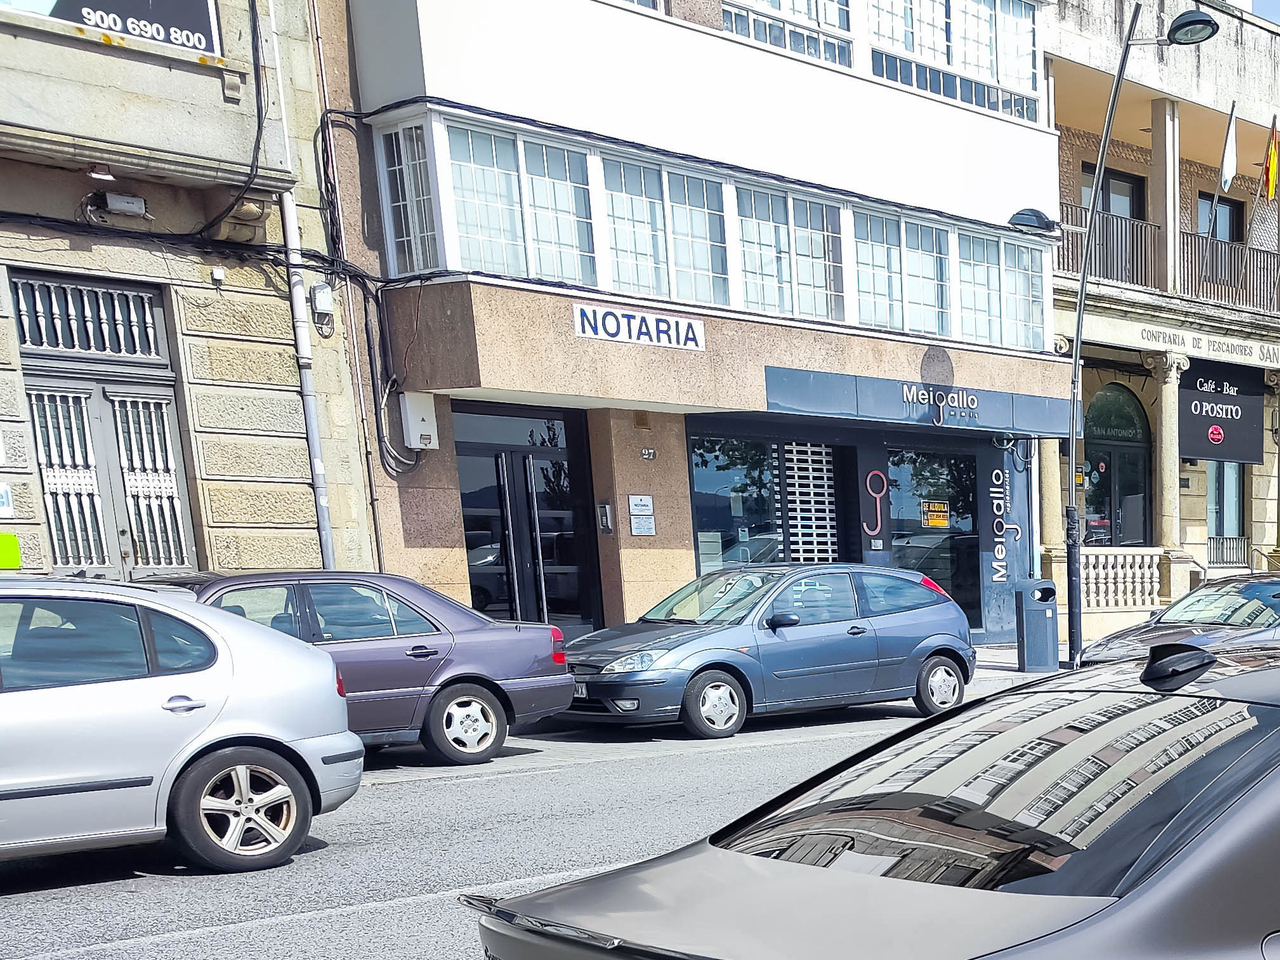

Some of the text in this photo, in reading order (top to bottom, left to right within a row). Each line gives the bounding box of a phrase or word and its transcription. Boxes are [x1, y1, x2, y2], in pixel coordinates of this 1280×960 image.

[81, 7, 207, 50] 900 690 800
[580, 308, 699, 348] NOTARIA
[1141, 328, 1186, 348] CONFRARIA
[1192, 337, 1203, 349] DE
[1207, 339, 1253, 357] PESCADORES
[1258, 344, 1280, 363] SAN
[902, 383, 978, 426] Meigallo
[1196, 378, 1216, 393] Café
[1222, 382, 1239, 396] Bar
[1191, 400, 1242, 420] O POSITO
[1092, 426, 1106, 436] SAN
[642, 448, 655, 459] 27
[989, 469, 1022, 582] Meigallo
